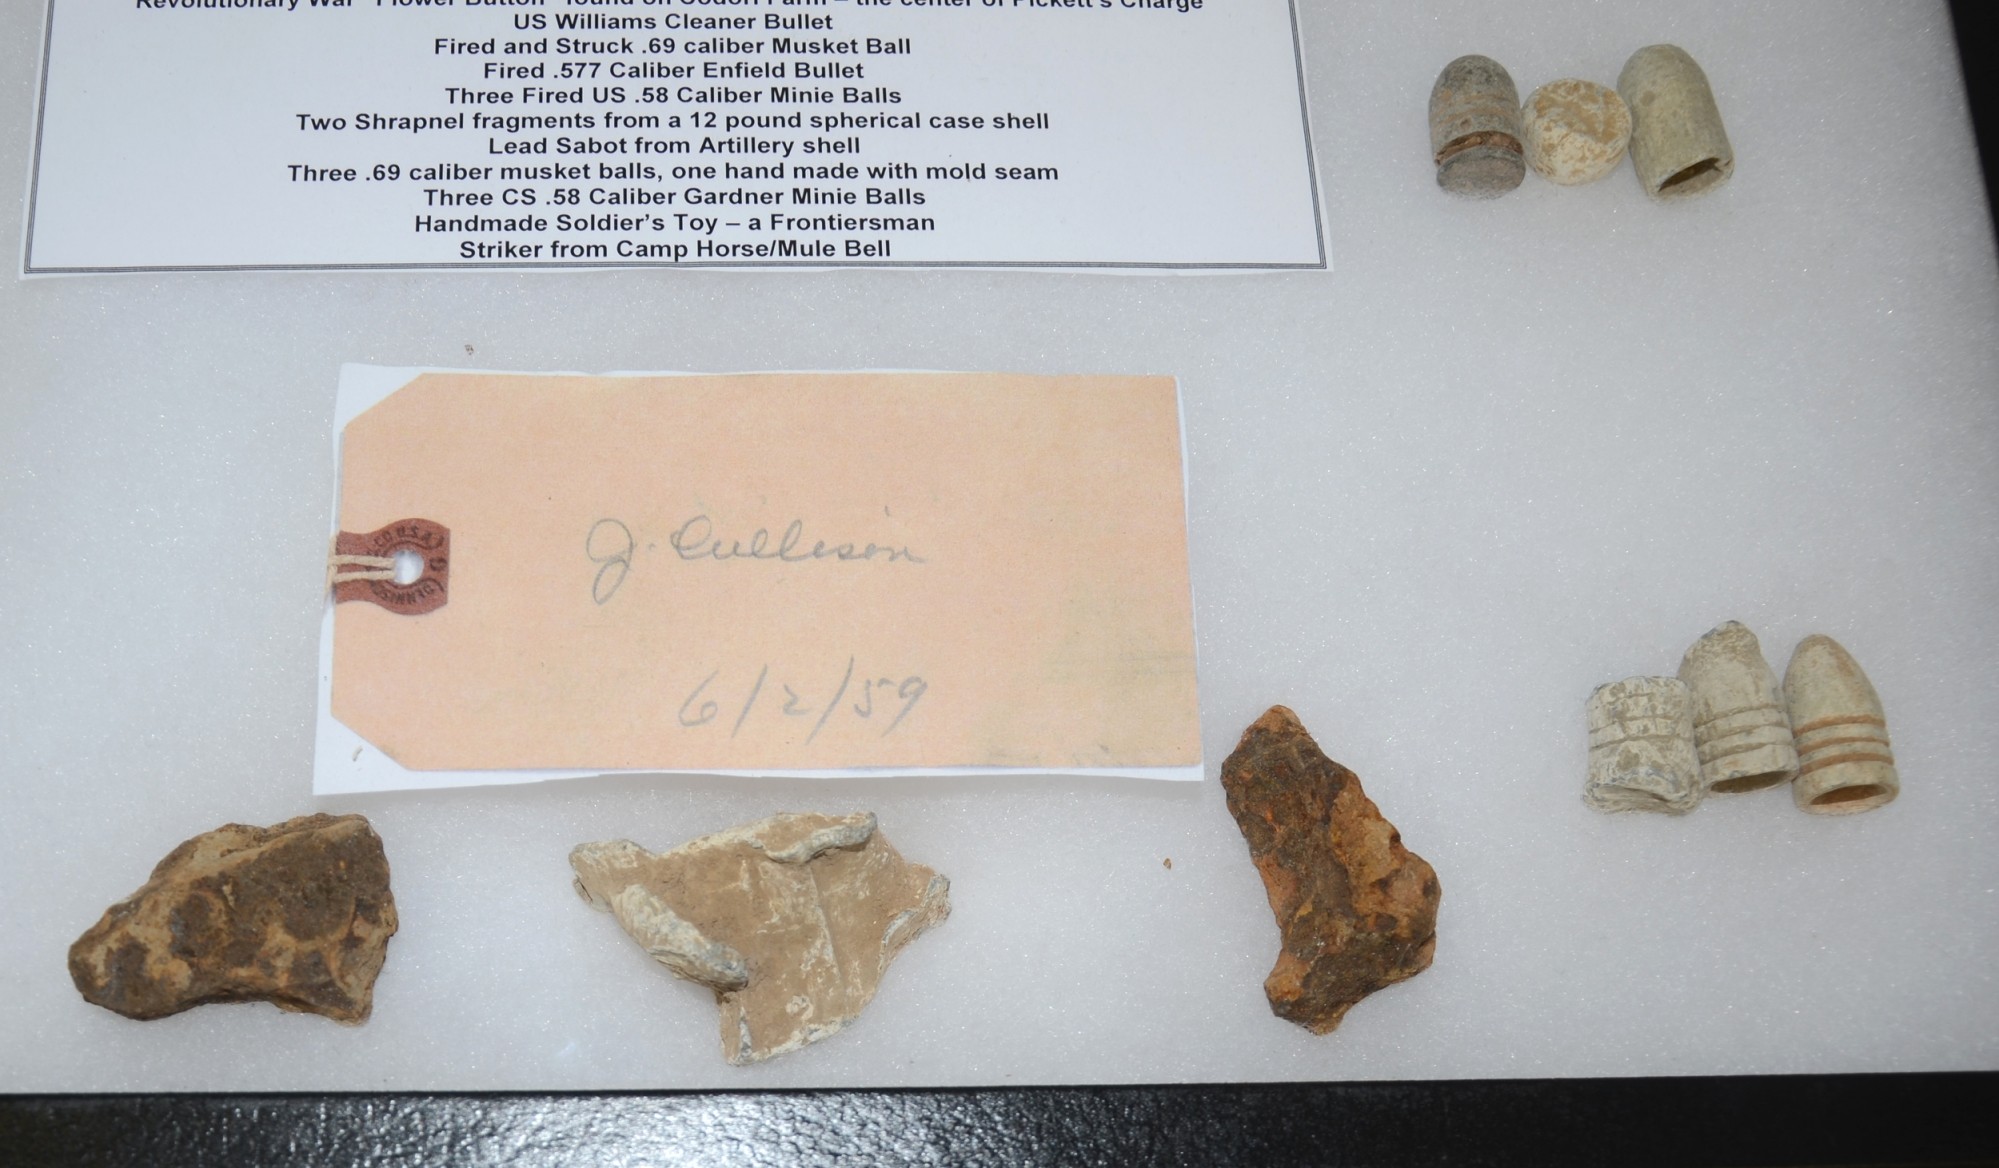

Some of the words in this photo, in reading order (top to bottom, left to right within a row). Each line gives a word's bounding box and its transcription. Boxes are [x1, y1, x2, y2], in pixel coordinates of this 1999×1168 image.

[514, 13, 547, 30] US
[555, 13, 657, 30] Williams
[665, 13, 757, 30] Cleaner
[764, 13, 833, 30] Bullet
[434, 38, 495, 55] Fired
[503, 37, 548, 55] and
[556, 37, 634, 54] Struck
[642, 37, 676, 54] .69
[684, 37, 765, 54] caliber
[772, 37, 859, 55] Musket
[866, 38, 911, 55] Ball
[484, 62, 545, 79] Fired
[553, 62, 601, 79] .577
[609, 61, 695, 79] Caliber
[703, 61, 785, 79] Enfield
[794, 61, 864, 79] Bullet
[444, 87, 514, 105] Three
[523, 86, 583, 104] Fired
[593, 86, 626, 104] US
[635, 86, 669, 104] .58
[677, 86, 763, 104] Caliber
[770, 86, 834, 104] Minie
[842, 87, 902, 104] Balls
[295, 114, 347, 131] Two
[355, 112, 464, 134] Shrapnel
[472, 112, 596, 134] fragments
[603, 111, 659, 129] from
[668, 115, 681, 129] a
[690, 111, 717, 128] 12
[726, 111, 802, 133] pound
[810, 111, 921, 133] spherical
[929, 116, 985, 129] case
[992, 112, 1049, 129] shell
[489, 137, 547, 155] Lead
[556, 136, 628, 154] Sabot
[634, 136, 690, 154] from
[699, 136, 795, 158] Artillery
[803, 136, 860, 154] shell
[287, 164, 357, 182] Three
[365, 163, 401, 181] .69
[409, 163, 493, 181] caliber
[500, 162, 591, 180] musket
[599, 162, 663, 183] balls,
[671, 166, 717, 179] one
[725, 162, 784, 179] hand
[793, 162, 859, 180] made
[866, 162, 918, 180] with
[926, 162, 986, 180] mold
[994, 167, 1059, 180] seam
[423, 189, 494, 206] Three
[502, 188, 537, 206] CS
[546, 188, 581, 206] .58
[589, 187, 677, 205] Caliber
[684, 187, 784, 205] Gardner
[792, 187, 857, 205] Minie
[865, 187, 926, 205] Balls
[415, 214, 548, 233] Handmade
[556, 213, 665, 232] Soldier’s
[673, 213, 718, 236] Toy
[748, 217, 761, 231] a
[770, 213, 935, 231] Frontiersman
[460, 240, 544, 259] Striker
[550, 240, 608, 258] from
[616, 239, 688, 263] Camp
[697, 239, 836, 258] Horse/Mule
[844, 239, 891, 257] Bell
[677, 653, 928, 746] 6/2/59
